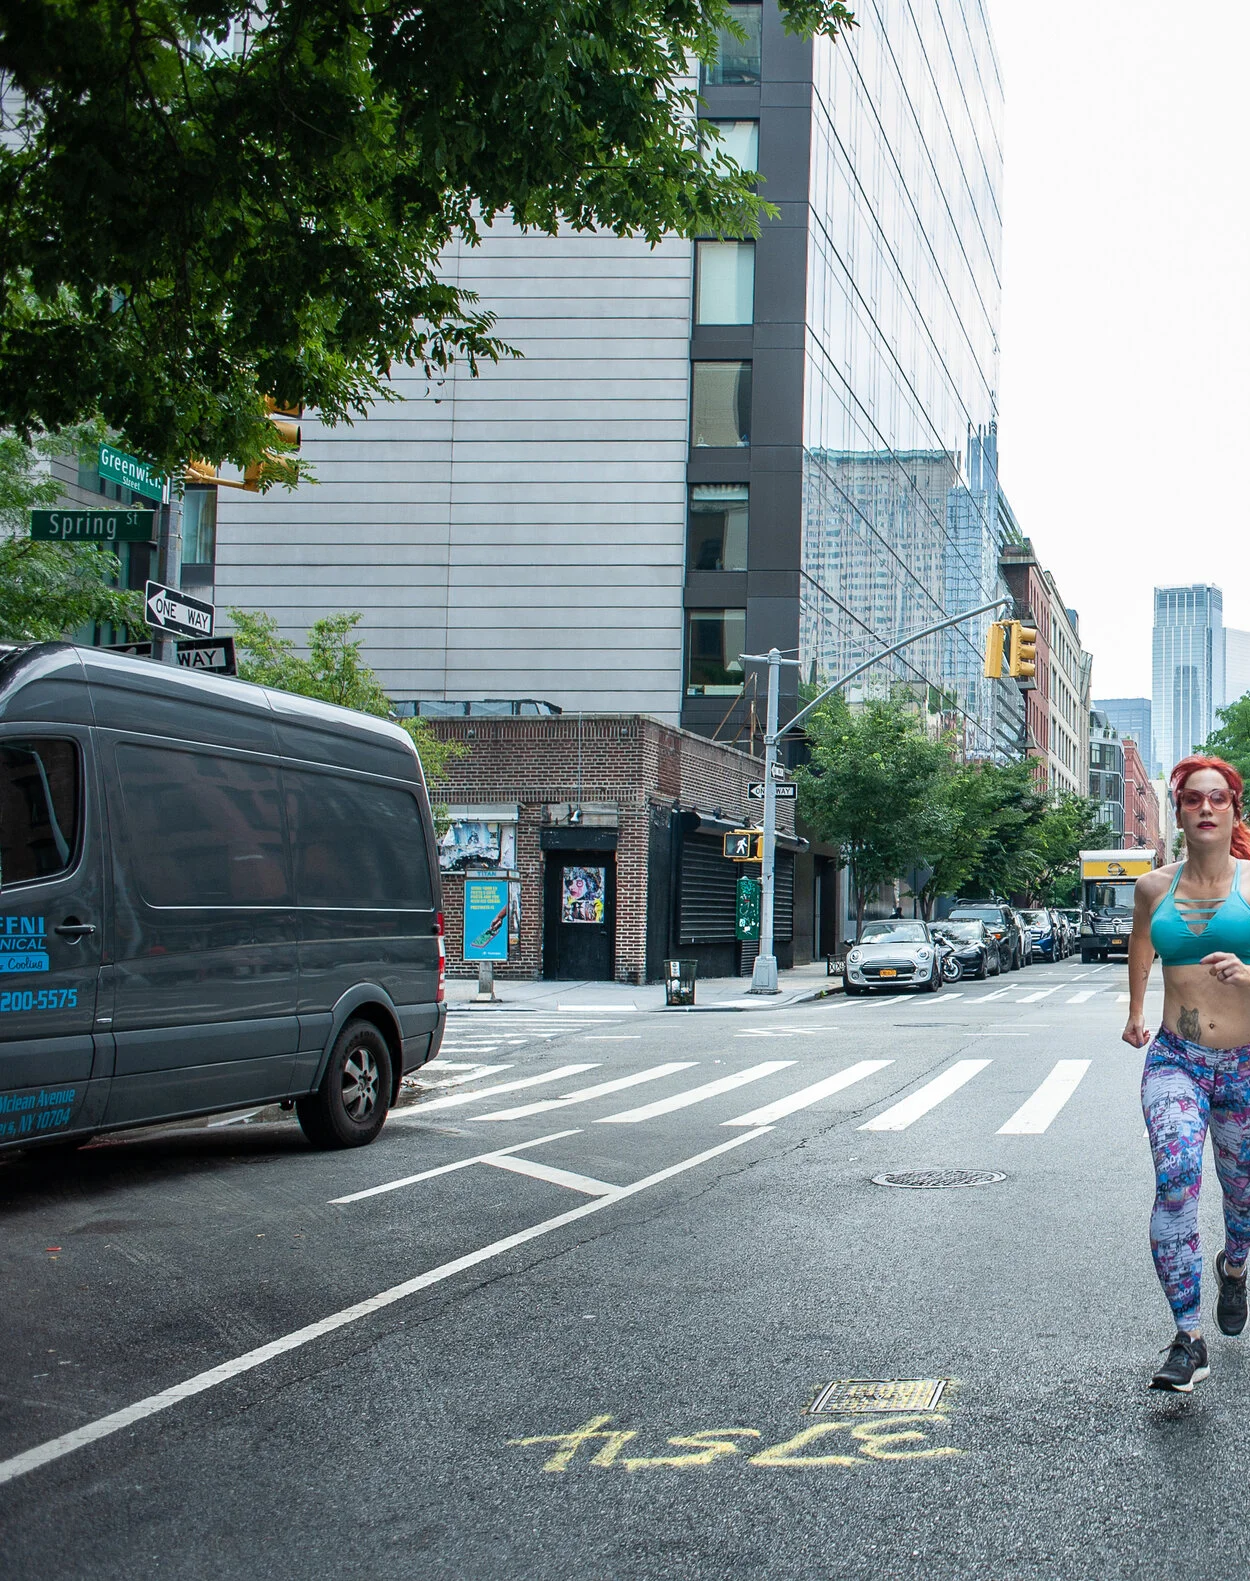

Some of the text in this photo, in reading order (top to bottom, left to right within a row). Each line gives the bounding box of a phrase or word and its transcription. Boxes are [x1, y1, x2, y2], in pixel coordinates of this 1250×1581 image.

[122, 475, 141, 491] Street
[49, 512, 138, 540] Spring St
[156, 598, 209, 630] ONE WAY
[177, 650, 217, 667] WAY
[0, 916, 45, 934] FNI
[8, 956, 43, 970] Cooling
[0, 988, 78, 1012] 200-5575
[37, 1088, 76, 1107] Avenue
[20, 1114, 35, 1133] NY
[36, 1107, 71, 1129] 10704
